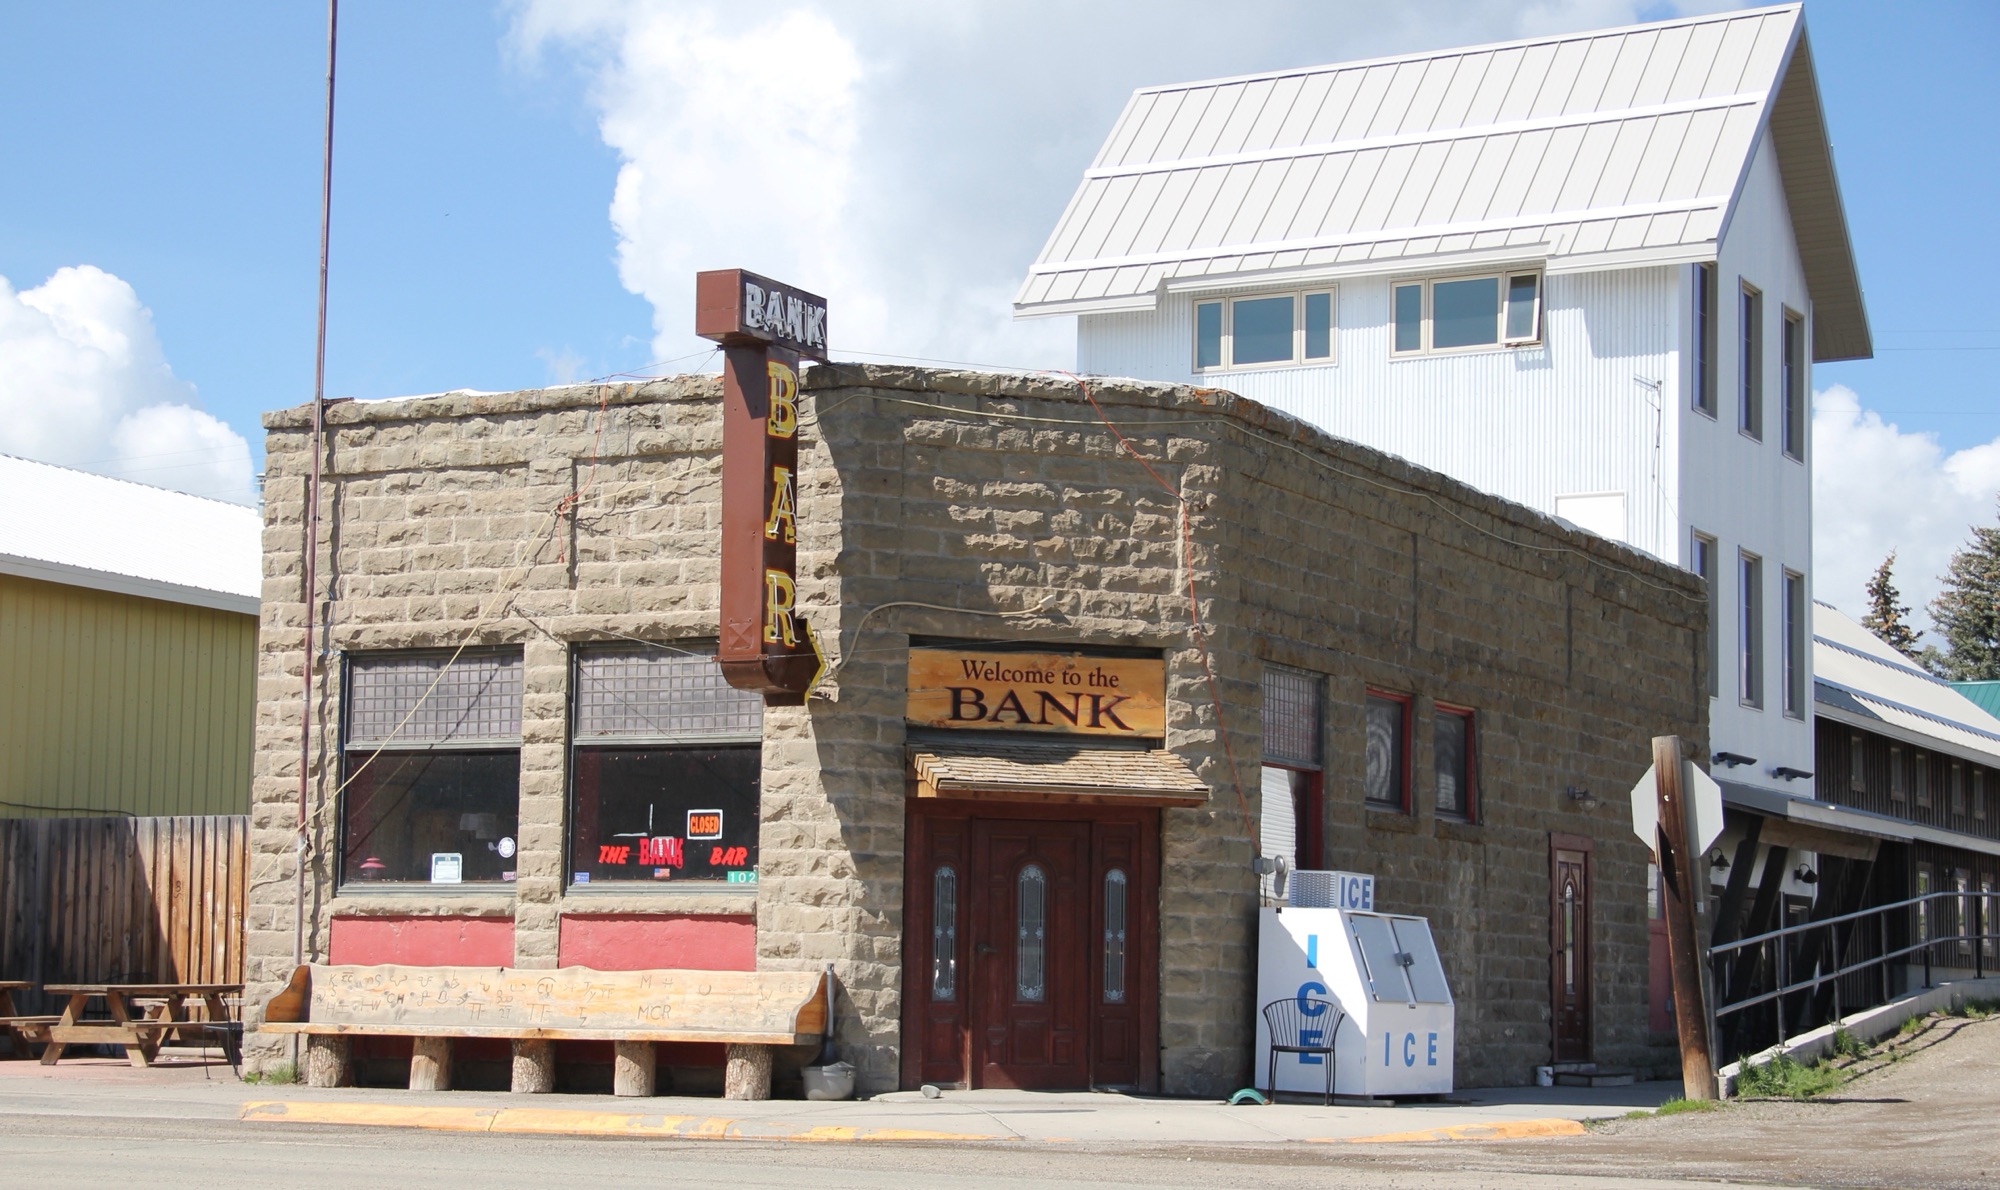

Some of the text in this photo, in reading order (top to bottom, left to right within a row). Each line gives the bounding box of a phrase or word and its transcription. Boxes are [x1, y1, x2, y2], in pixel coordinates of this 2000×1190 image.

[745, 282, 827, 350] BANK
[764, 359, 801, 649] BAR
[961, 658, 1120, 689] Welcome to the
[946, 686, 1135, 731] BANK
[690, 816, 719, 833] CLOSED
[599, 838, 747, 869] THE BANK BAR
[730, 872, 757, 883] 102
[1341, 877, 1371, 909] ICE
[637, 1003, 672, 1021] MCR
[1297, 935, 1326, 1064] ICE
[1385, 1032, 1437, 1067] ICE
